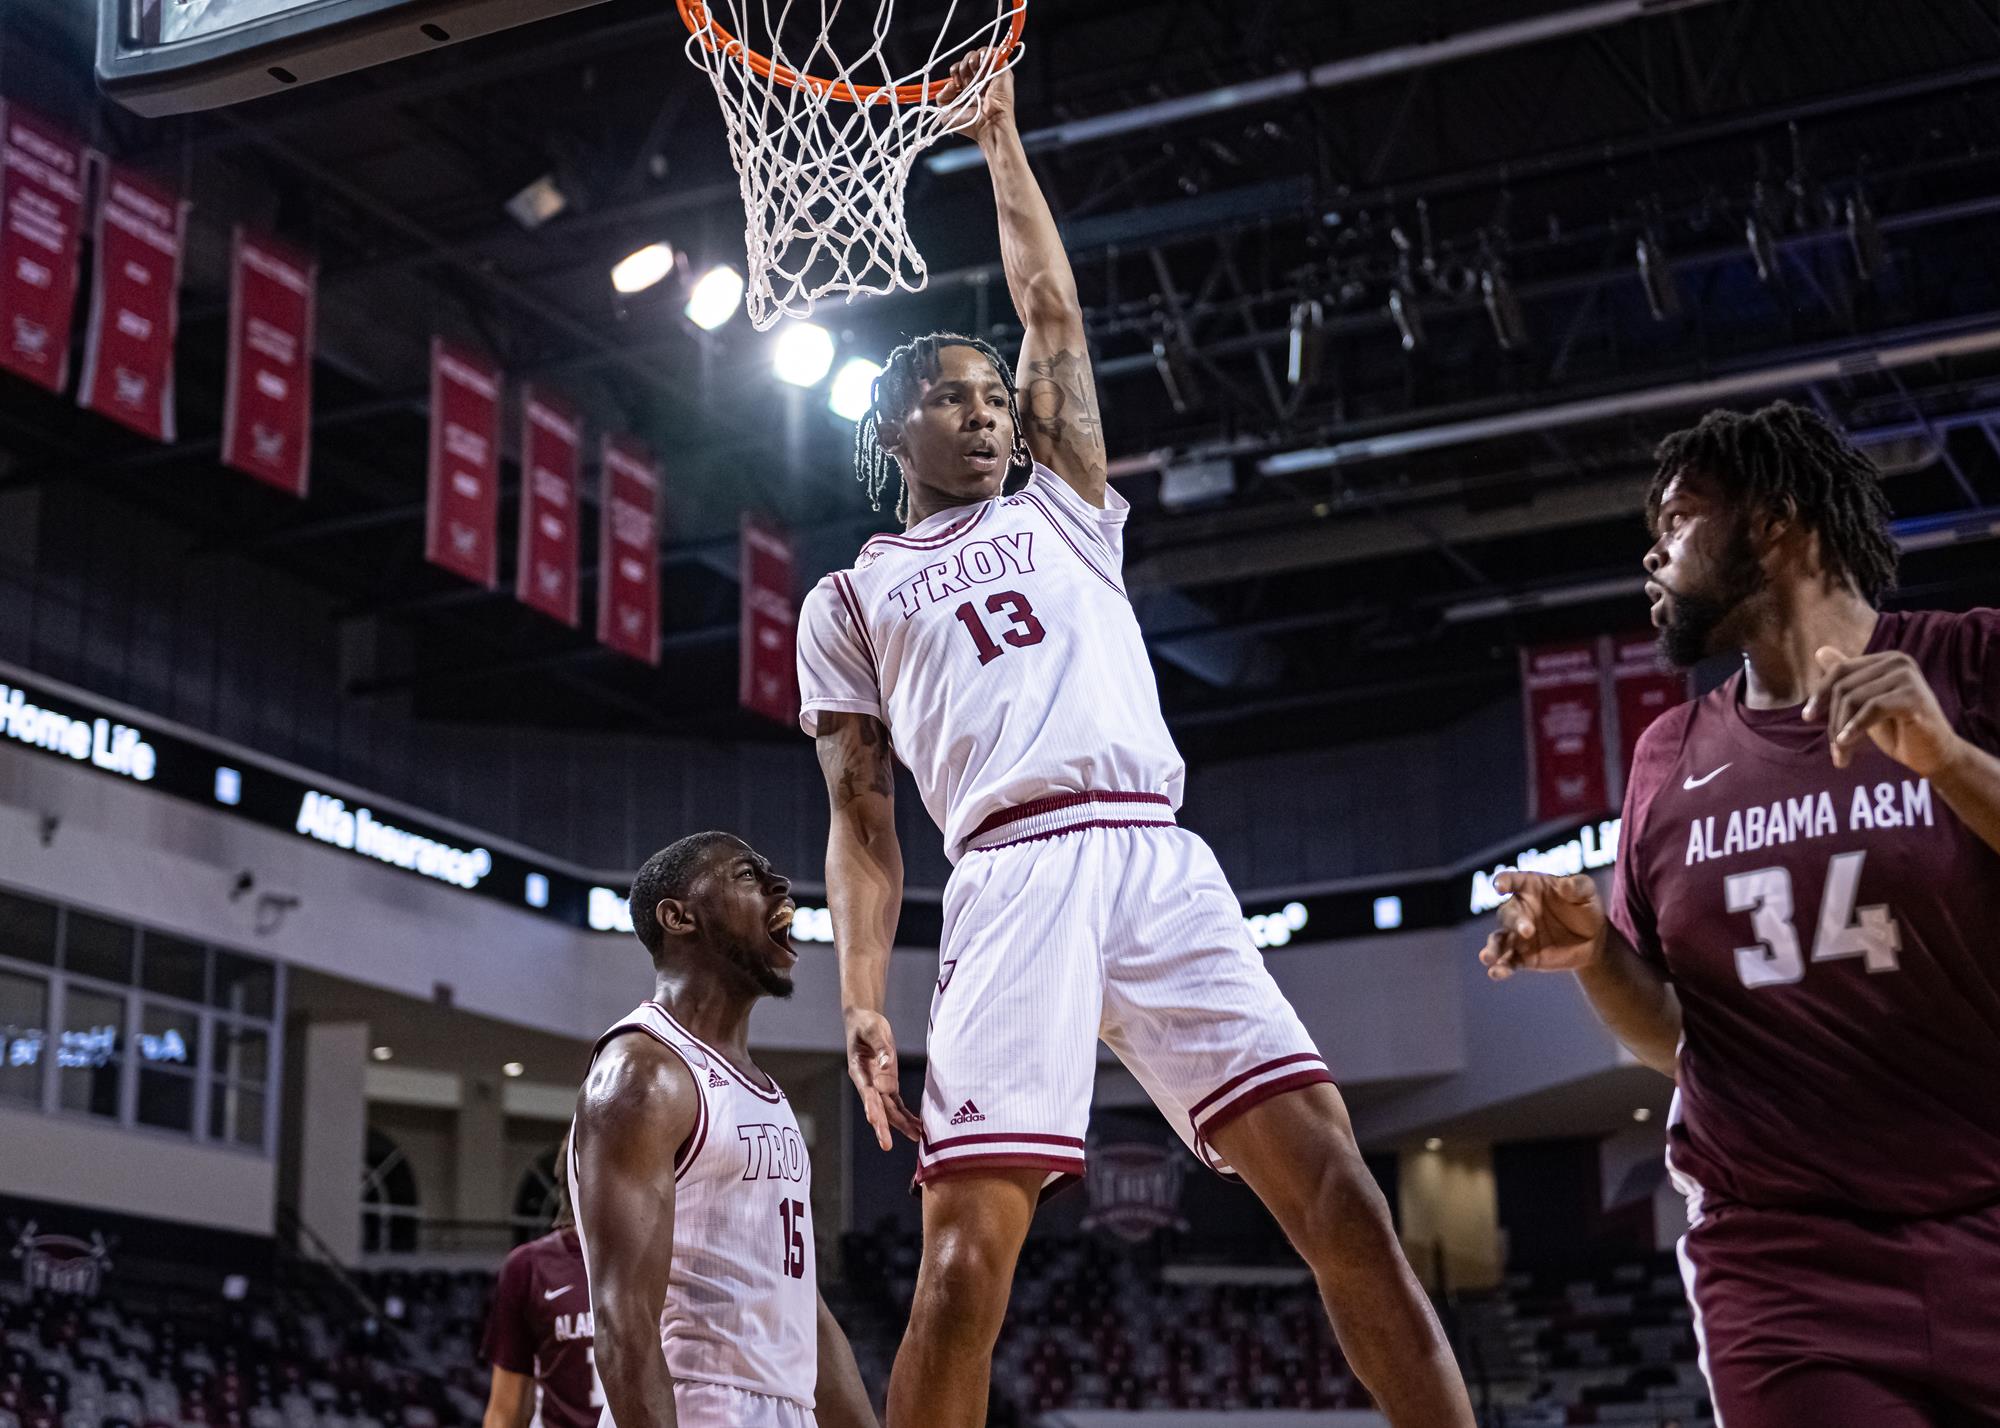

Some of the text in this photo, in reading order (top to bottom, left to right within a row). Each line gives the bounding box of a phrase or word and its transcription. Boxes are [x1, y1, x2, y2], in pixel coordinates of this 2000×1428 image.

[887, 532, 1035, 620] TROY
[955, 590, 1047, 666] 13
[0, 684, 156, 780] Home Life
[296, 791, 355, 848] Alfa
[1685, 777, 1935, 866] ALABAMA A&M
[1722, 850, 1903, 990] 34
[950, 1113, 986, 1126] adidas
[779, 1197, 805, 1280] 15
